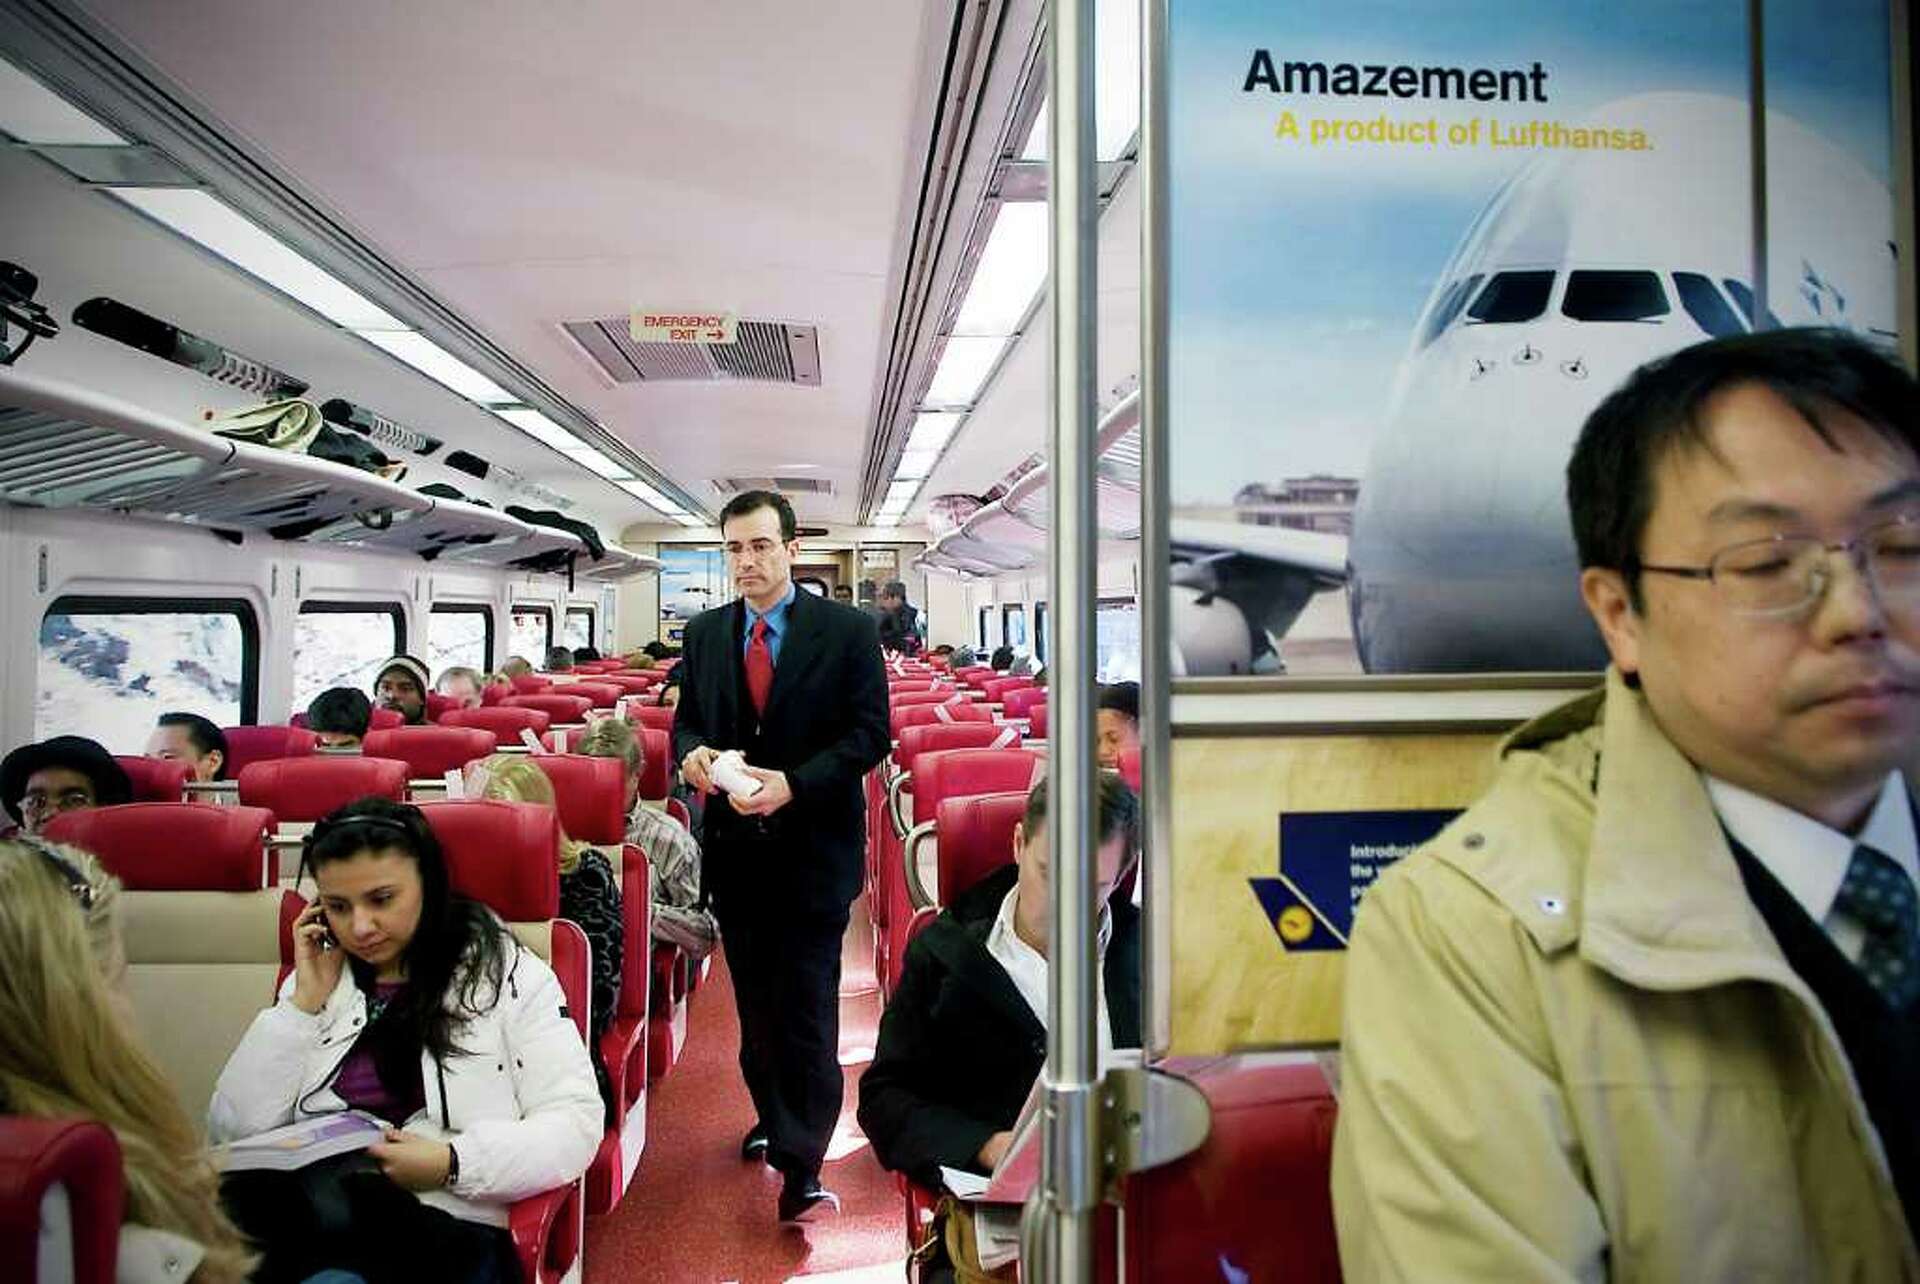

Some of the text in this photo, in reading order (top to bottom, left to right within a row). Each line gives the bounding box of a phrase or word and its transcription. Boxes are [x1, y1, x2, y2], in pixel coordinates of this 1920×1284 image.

[1243, 49, 1548, 103] Amazement
[1275, 111, 1654, 151] A product of Lufthansa.
[644, 316, 723, 328] EMERGENCY
[671, 329, 697, 340] EXIT
